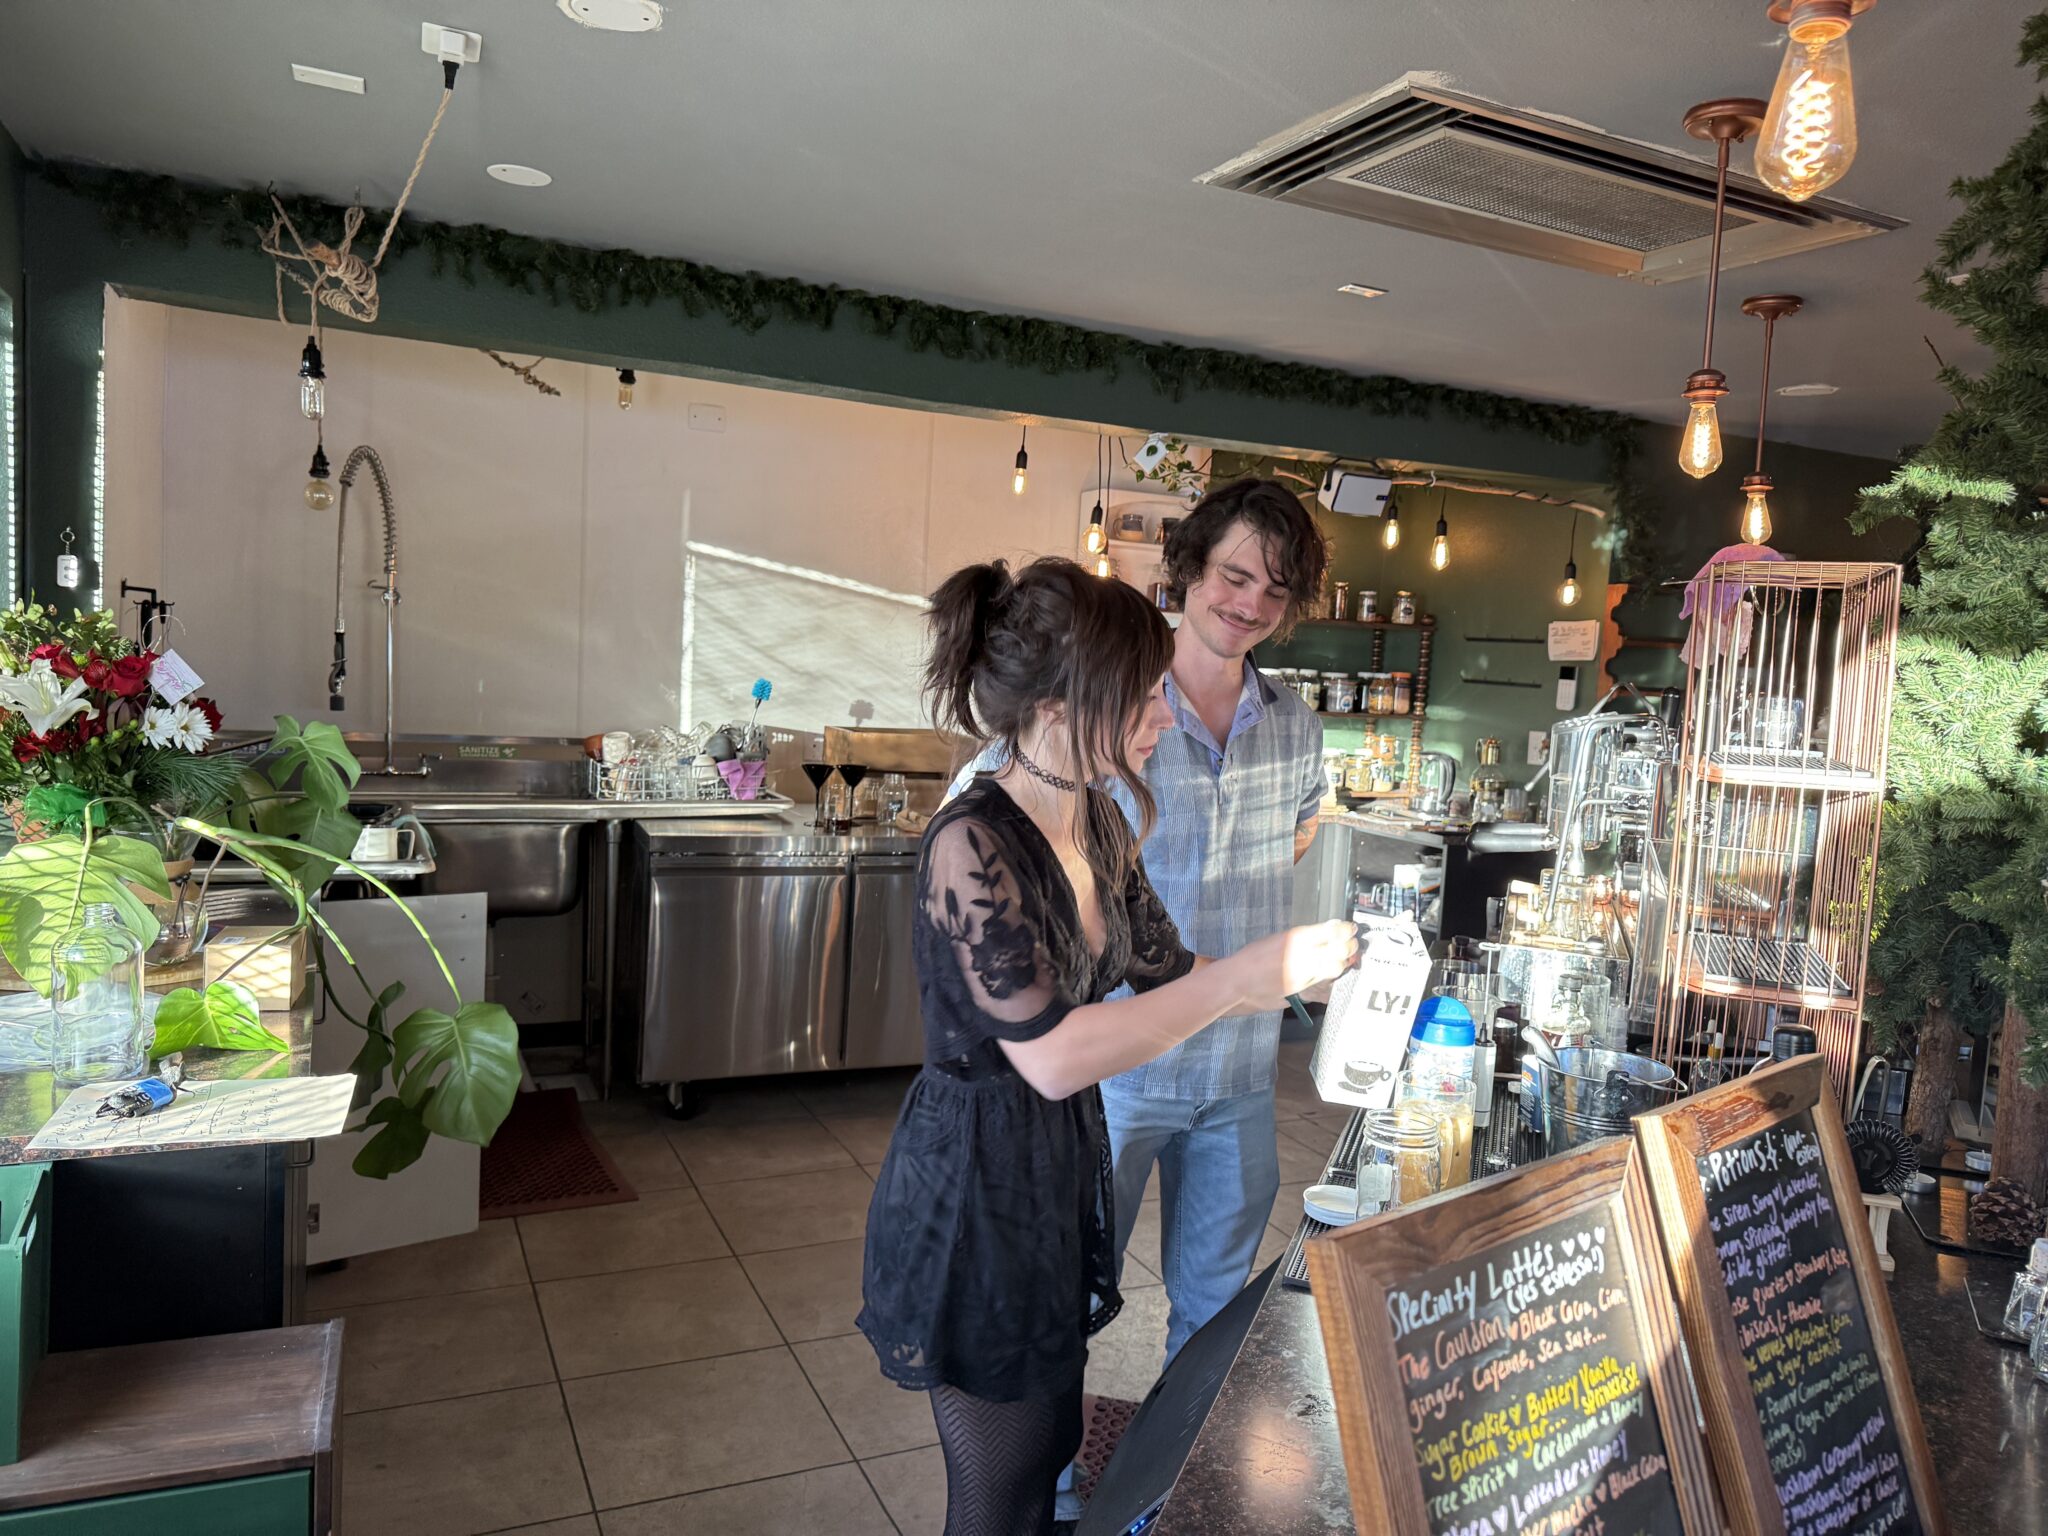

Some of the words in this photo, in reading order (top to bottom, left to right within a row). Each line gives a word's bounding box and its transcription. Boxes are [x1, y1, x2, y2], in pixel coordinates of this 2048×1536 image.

[1367, 990, 1411, 1015] LY!
[1732, 1296, 1750, 1316] ose
[1397, 1353, 1431, 1386] The
[1434, 1315, 1507, 1371] Cauldron
[1519, 1303, 1558, 1342] Black
[1738, 1315, 1780, 1351] ibiscus,
[1410, 1375, 1465, 1434] ginger,
